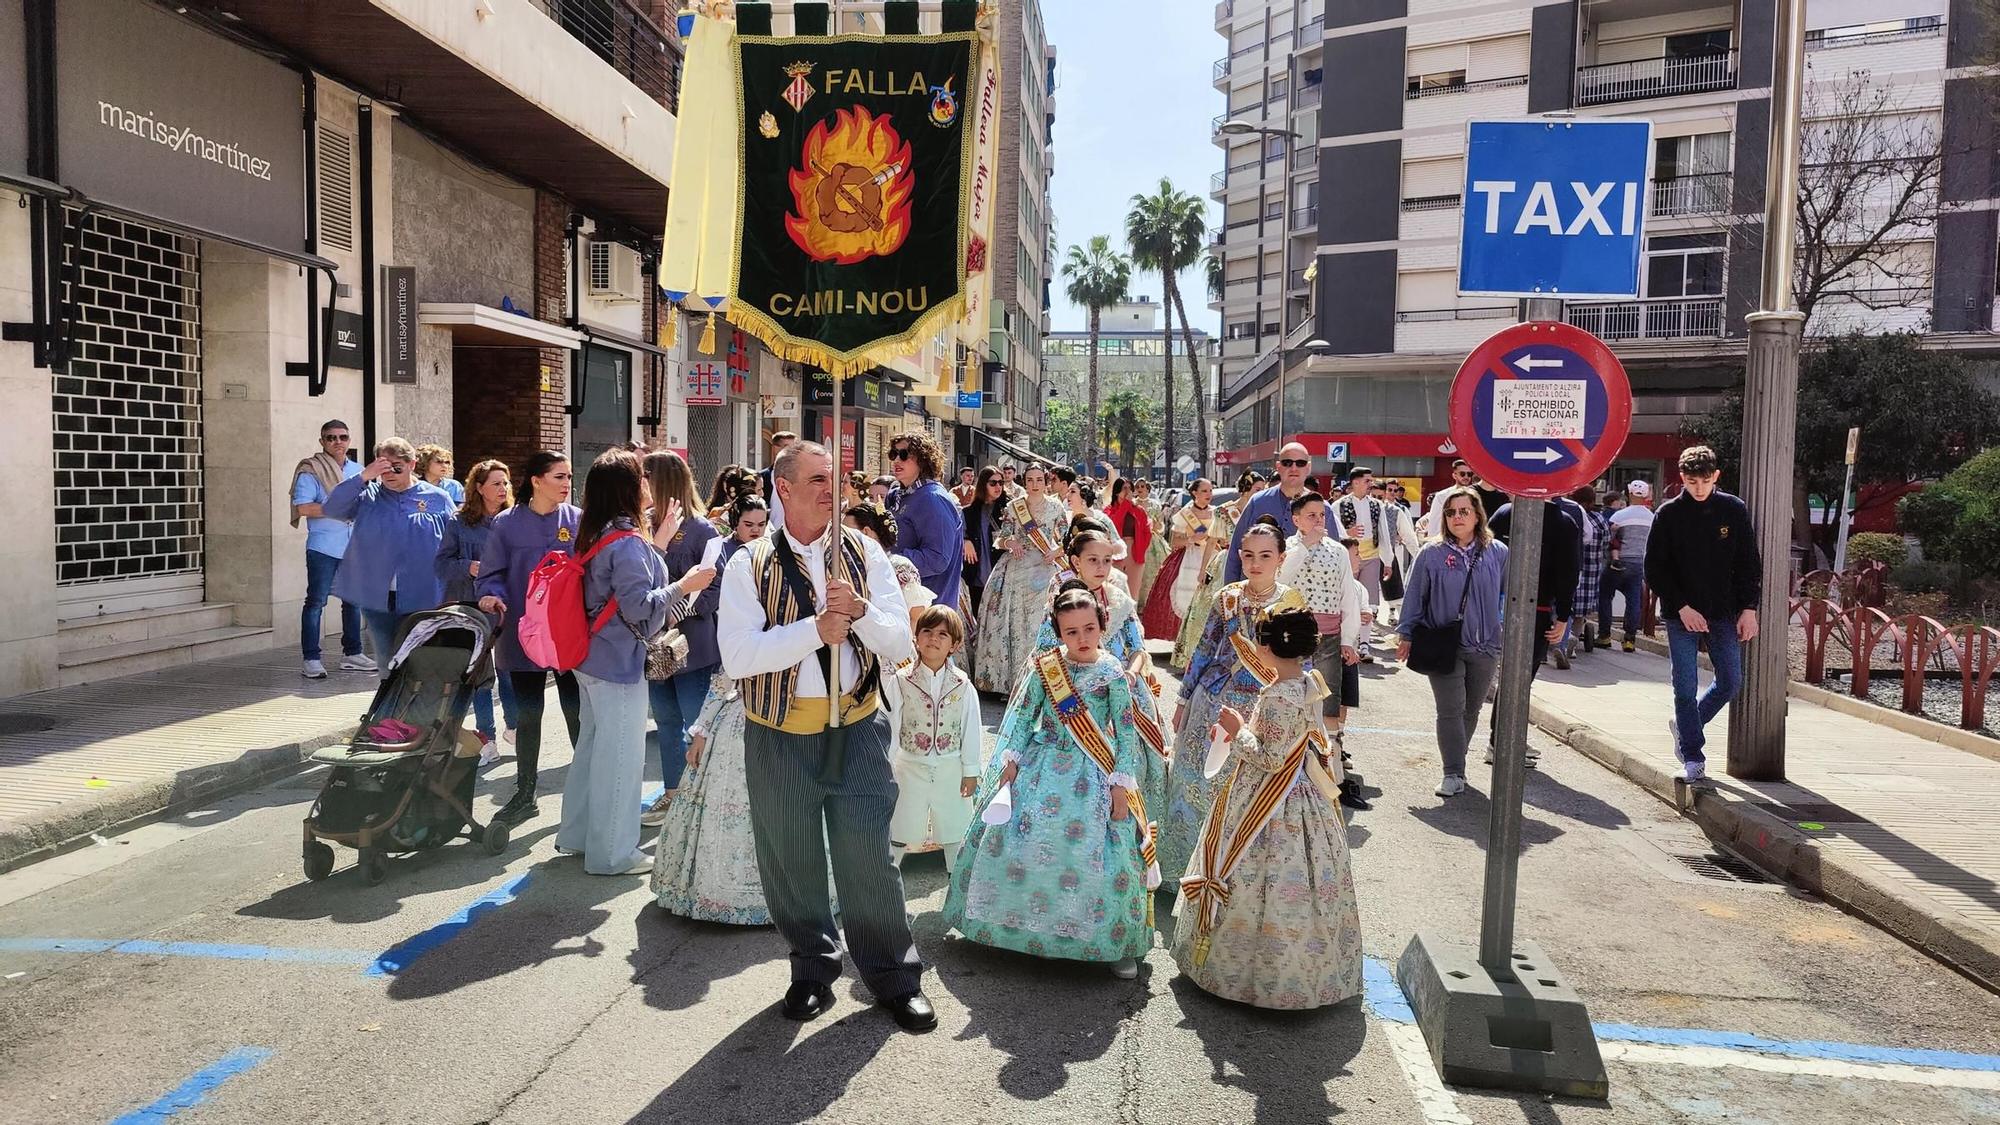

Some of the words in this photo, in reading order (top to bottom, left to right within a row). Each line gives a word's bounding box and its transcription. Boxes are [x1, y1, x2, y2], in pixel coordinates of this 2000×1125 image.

[825, 68, 928, 96] FALLA
[980, 68, 997, 146] Fallera
[973, 156, 989, 222] Major
[1473, 180, 1638, 236] TAXI
[769, 286, 928, 317] CAMI-NOU
[1513, 409, 1579, 419] ESTACIONAR
[1518, 400, 1575, 409] PROHIBIDO
